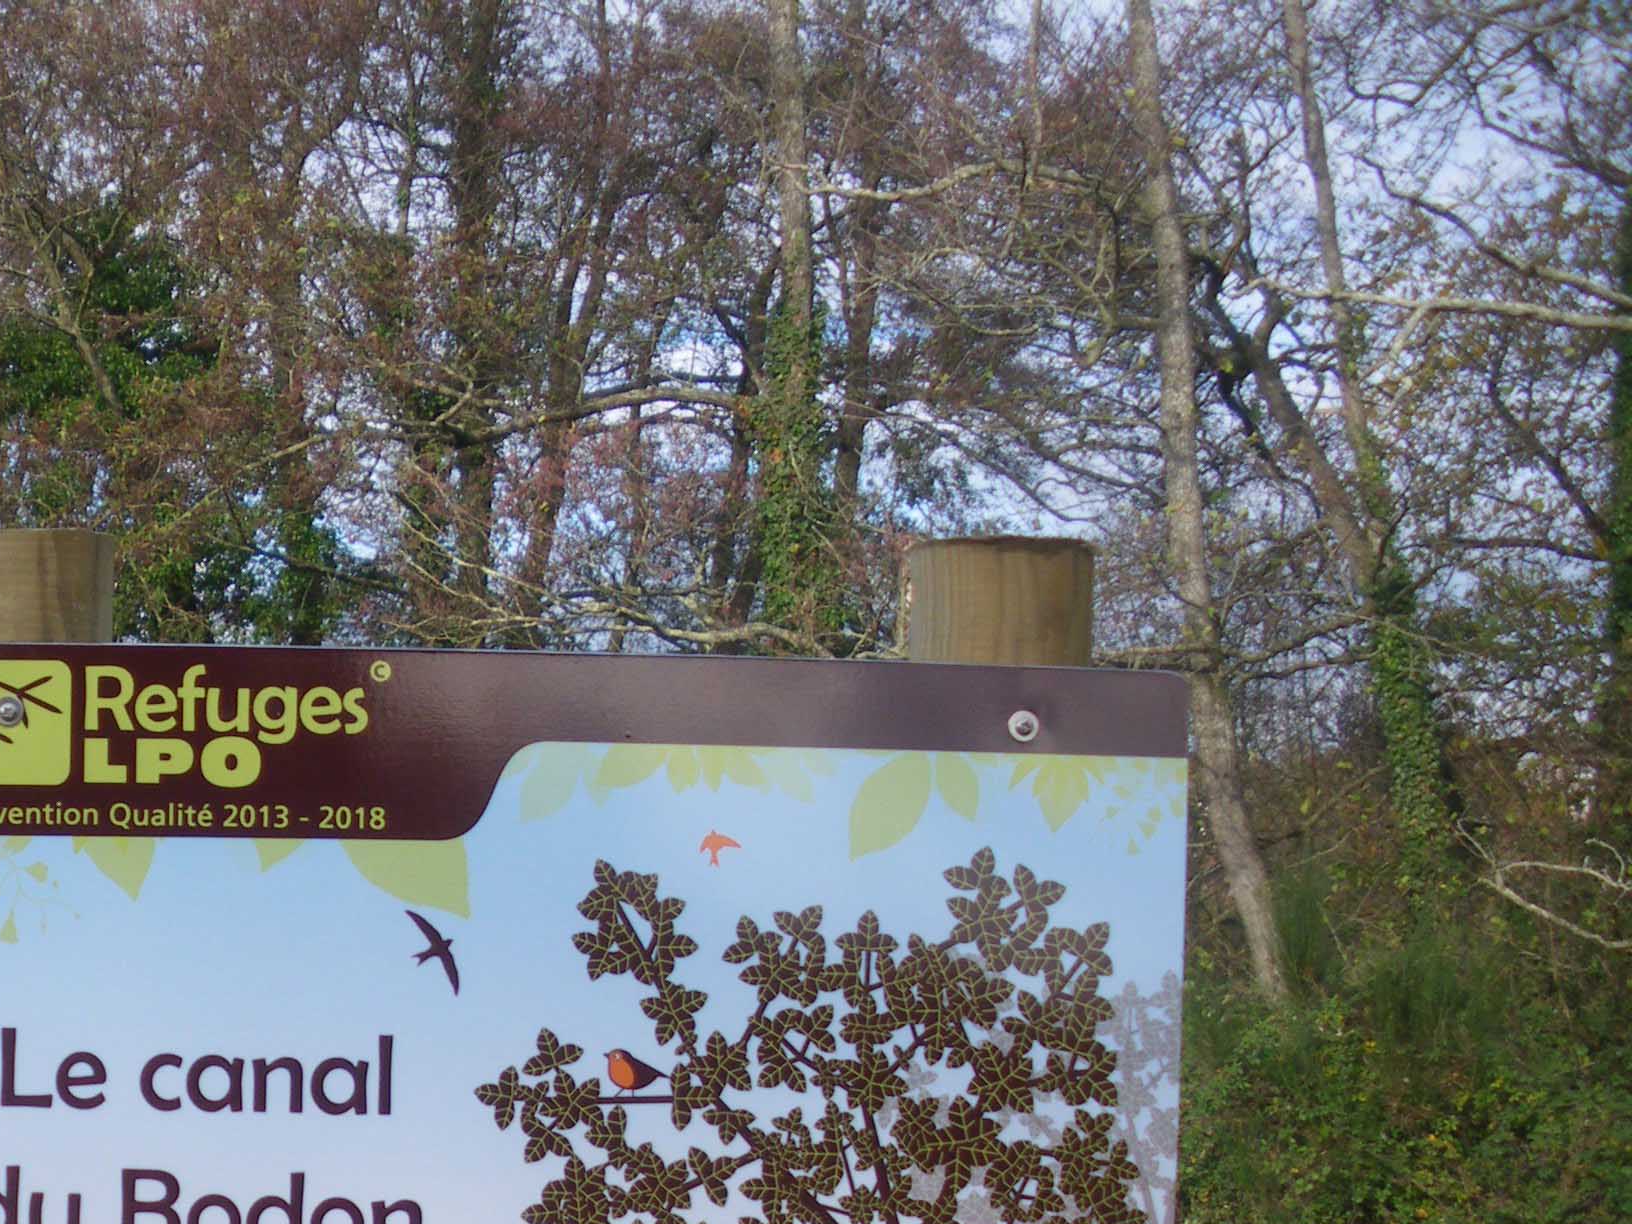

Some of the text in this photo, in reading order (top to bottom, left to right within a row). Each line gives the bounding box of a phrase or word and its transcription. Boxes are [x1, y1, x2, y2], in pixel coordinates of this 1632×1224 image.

[83, 663, 369, 745] Refuges
[83, 736, 262, 788] LPO
[109, 802, 214, 831] Qualité
[223, 804, 289, 829] 2013
[318, 806, 386, 830] 2018
[0, 1026, 395, 1117] Le canal
